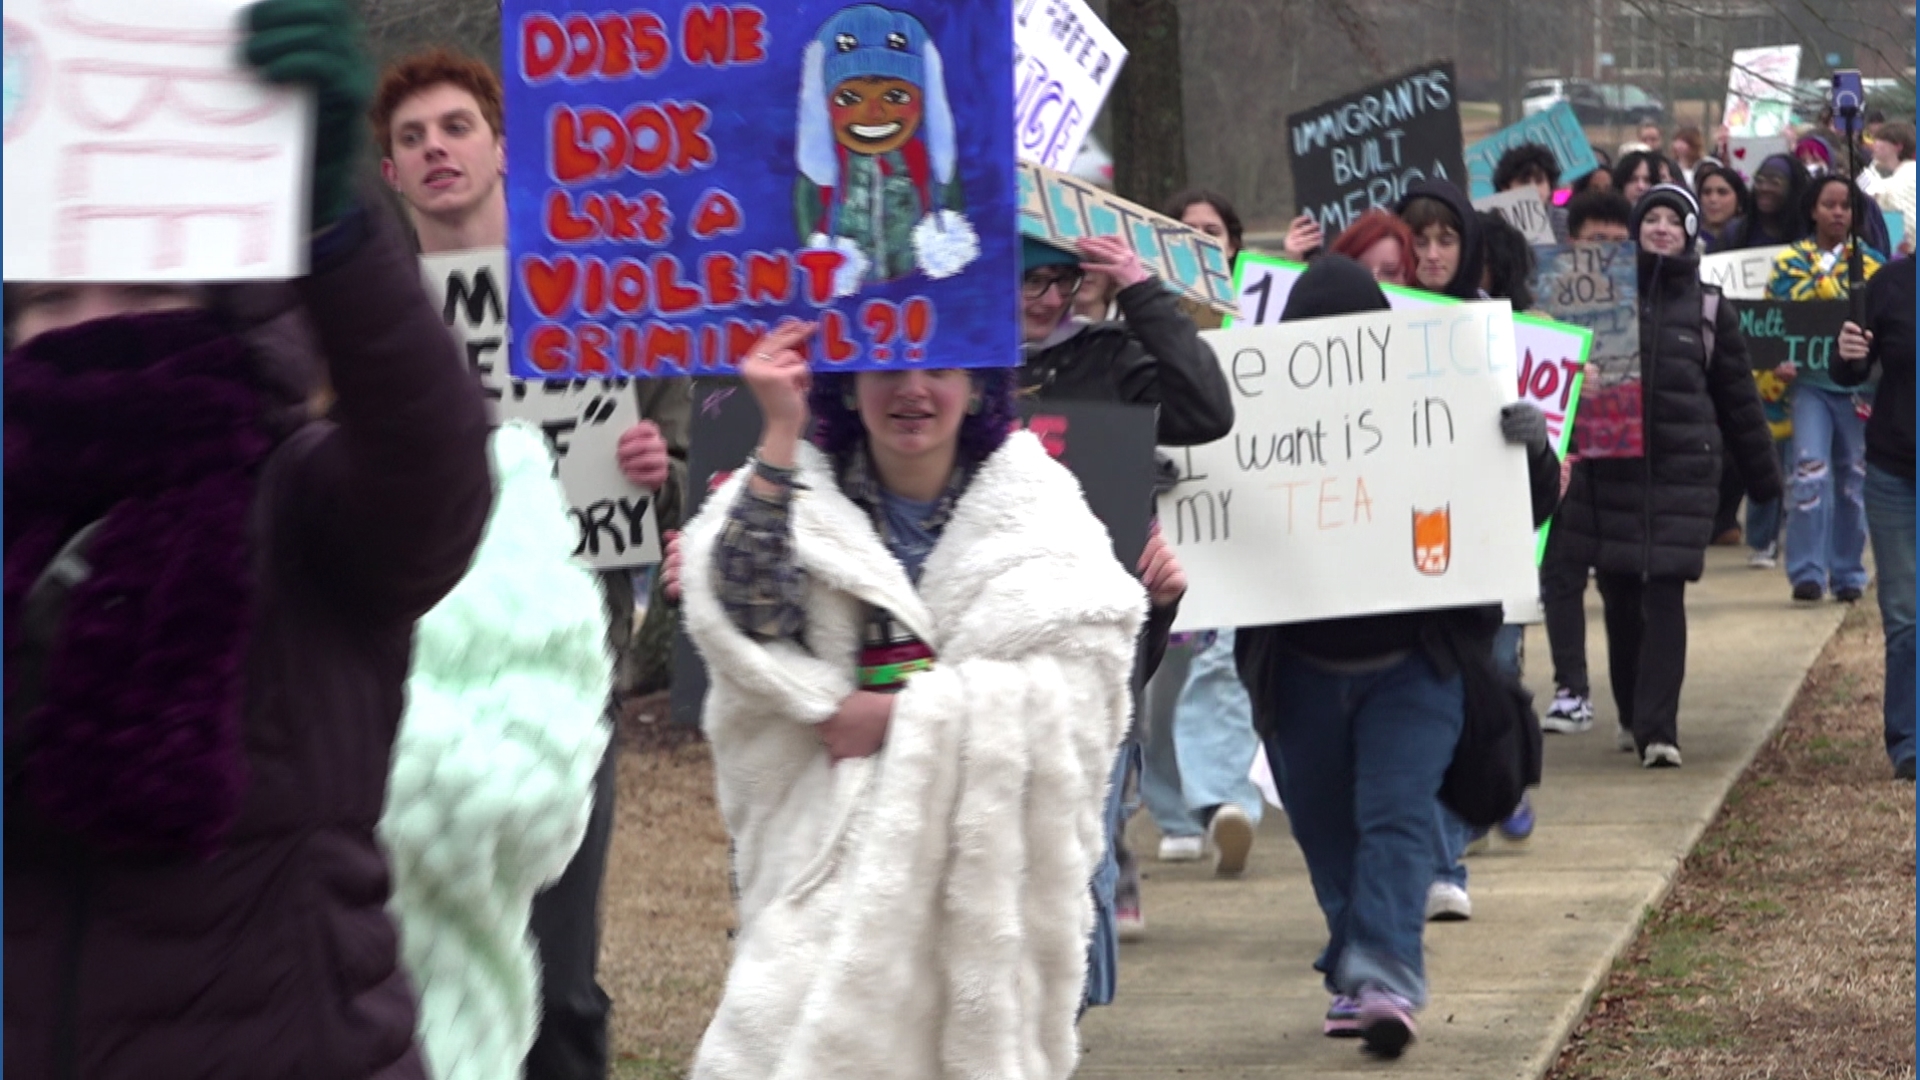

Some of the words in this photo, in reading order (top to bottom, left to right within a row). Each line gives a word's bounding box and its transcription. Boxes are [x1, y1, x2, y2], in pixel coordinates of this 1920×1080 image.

[520, 12, 671, 83] DOES
[549, 100, 716, 185] LOOK
[1292, 70, 1451, 156] IMMIGRANTS
[1331, 128, 1405, 185] BUILT
[545, 189, 672, 246] LIKE
[690, 187, 744, 238] A
[522, 247, 850, 319] VIOLENT
[1557, 275, 1615, 306] FOR
[1571, 247, 1619, 273] ALL
[524, 297, 936, 376] CRIMINL?!
[1407, 313, 1508, 380] ICE
[1738, 307, 1784, 338] Melt
[1235, 419, 1328, 471] want
[1412, 396, 1455, 448] in
[1266, 476, 1373, 534] TEA
